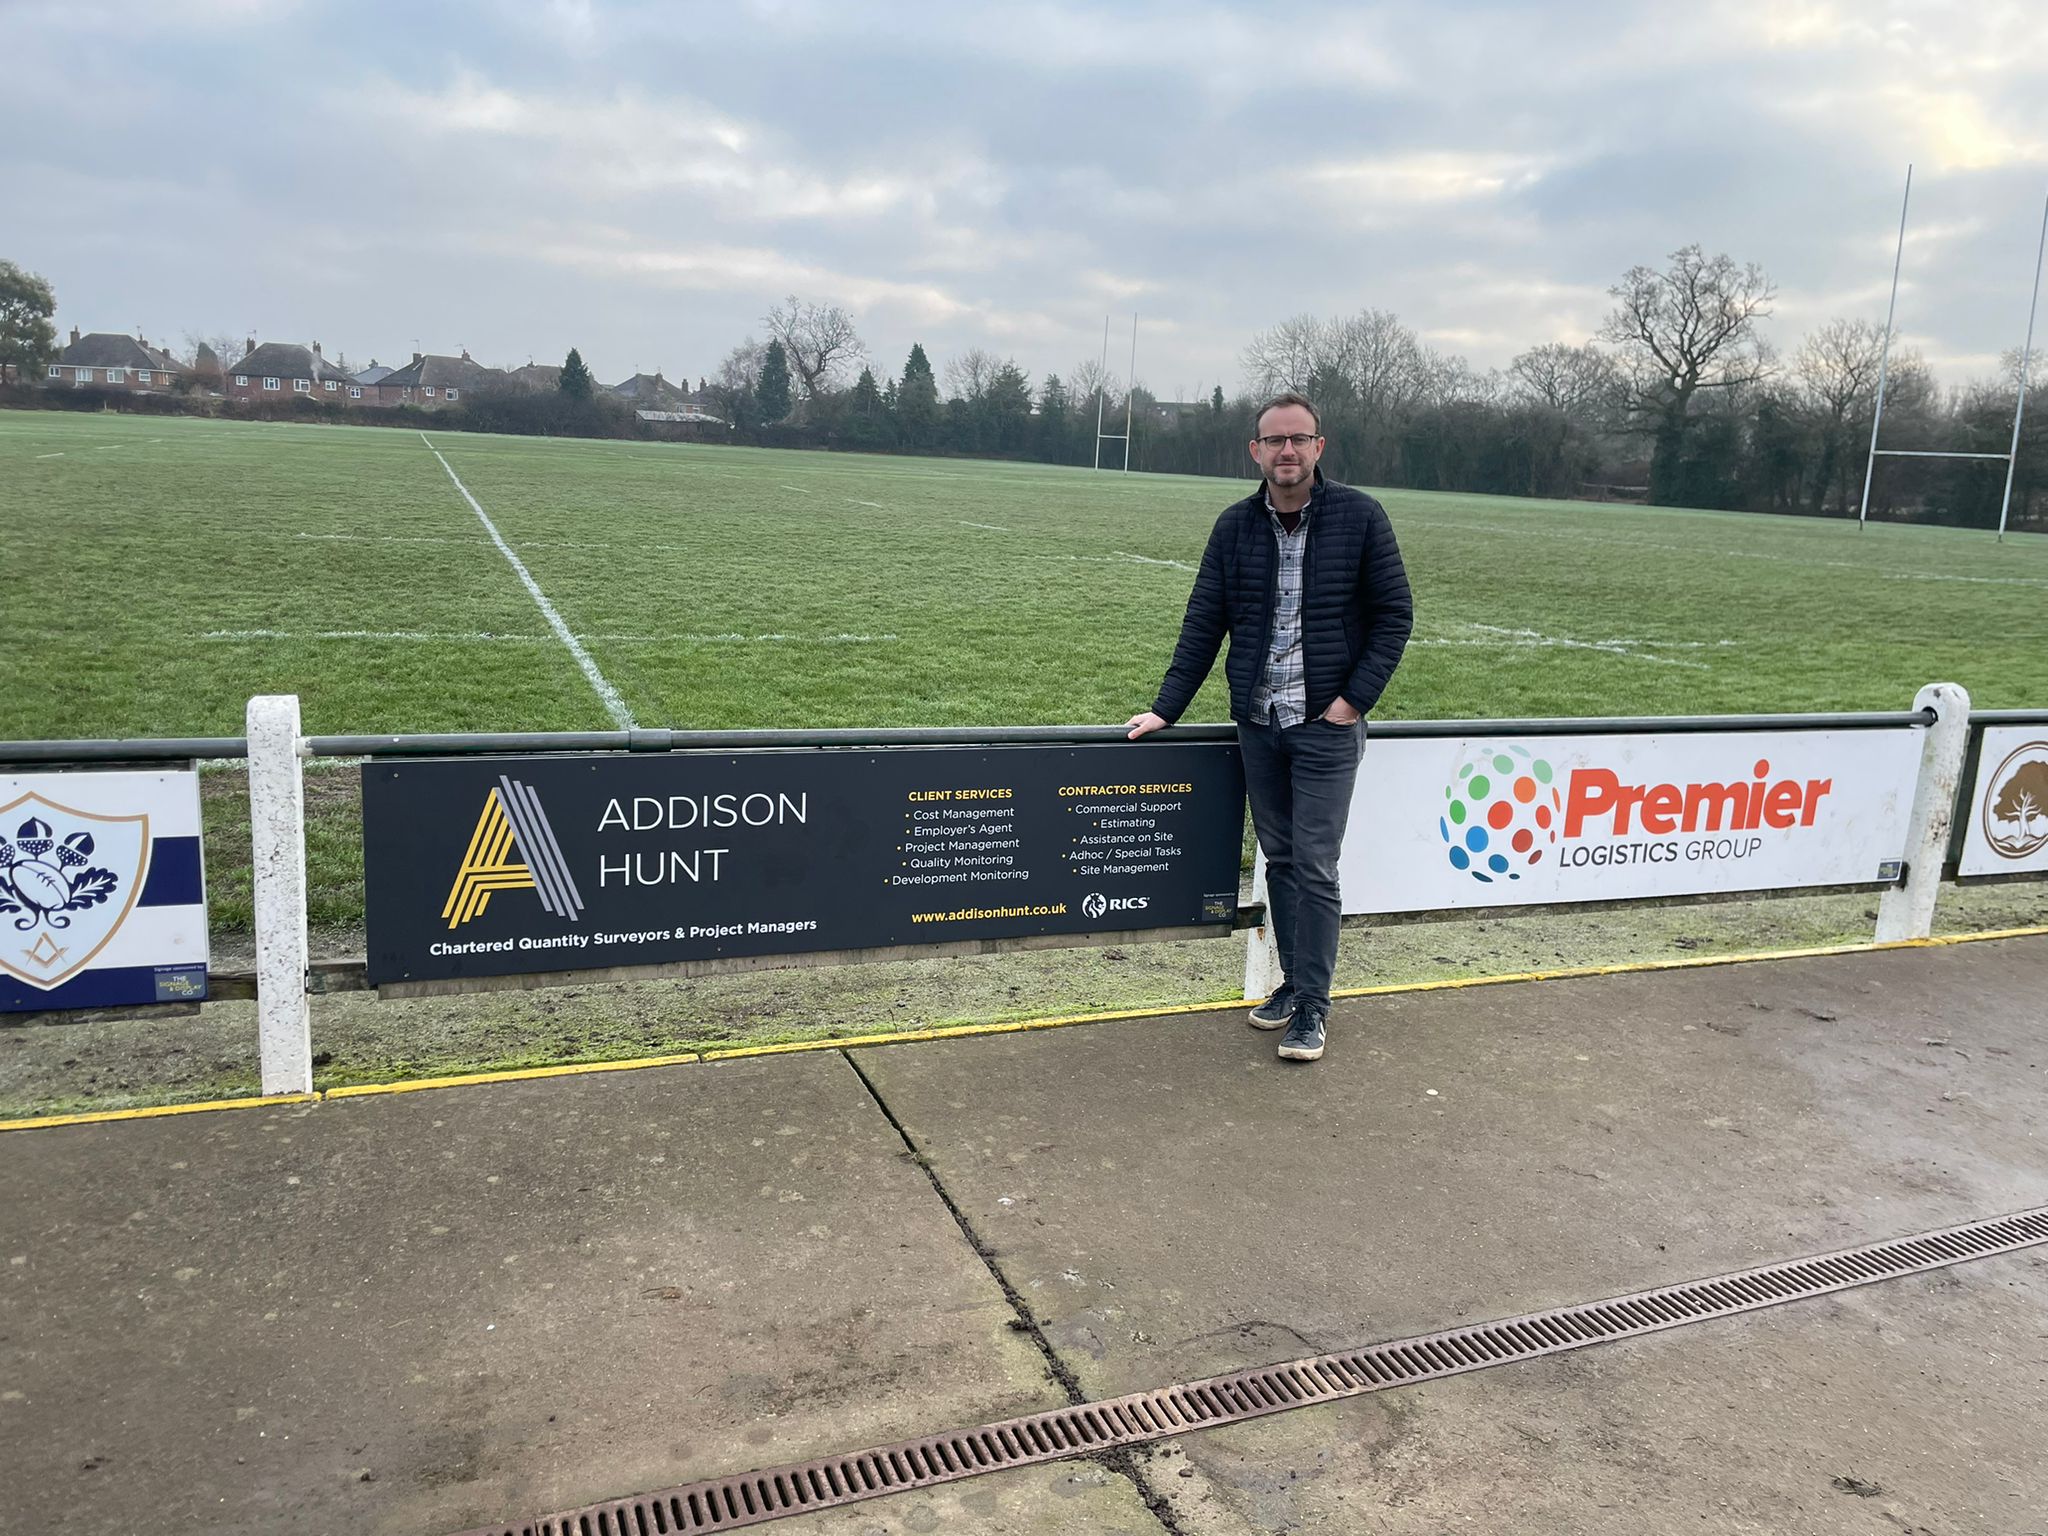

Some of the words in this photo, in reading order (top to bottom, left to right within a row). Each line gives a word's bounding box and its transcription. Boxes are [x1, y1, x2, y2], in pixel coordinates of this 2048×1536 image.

[908, 790, 952, 802] CLIENT
[954, 788, 1013, 800] SERVICES
[1058, 784, 1137, 797] CONTRACTOR
[1139, 783, 1193, 794] SERVICES
[1563, 758, 1832, 838] Premier
[597, 792, 808, 833] ADDISON
[913, 809, 940, 821] Cost
[942, 807, 1015, 820] Management
[1075, 803, 1138, 815] Commercial
[1139, 801, 1182, 815] Support
[978, 823, 1013, 836] Agent
[1100, 817, 1156, 830] Estimating
[1079, 833, 1136, 845] Assistance
[1137, 834, 1151, 843] on
[1153, 831, 1174, 842] Site
[905, 840, 945, 854] Project
[947, 838, 1020, 852] Management
[1068, 848, 1104, 861] Adhoc
[1105, 848, 1113, 861] /
[1114, 847, 1152, 861] Special
[1154, 846, 1182, 858] Tasks
[1559, 841, 1678, 868] LOGISTICS
[1685, 837, 1762, 861] GROUP
[599, 848, 730, 888] HUNT
[910, 857, 952, 870] Quality
[954, 853, 1014, 867] Monitoring
[1080, 864, 1101, 876] Site
[1103, 861, 1170, 875] Management
[892, 872, 968, 887] Development
[970, 868, 1029, 883] Monitoring
[1109, 896, 1148, 911] RICS
[911, 902, 1067, 924] www.addisonhunt.co.uk
[429, 937, 514, 957] Chartered
[518, 932, 590, 952] Quantity
[593, 928, 671, 946] Surveyors
[674, 926, 686, 939] &
[689, 922, 744, 940] Project
[747, 918, 817, 937] Managers
